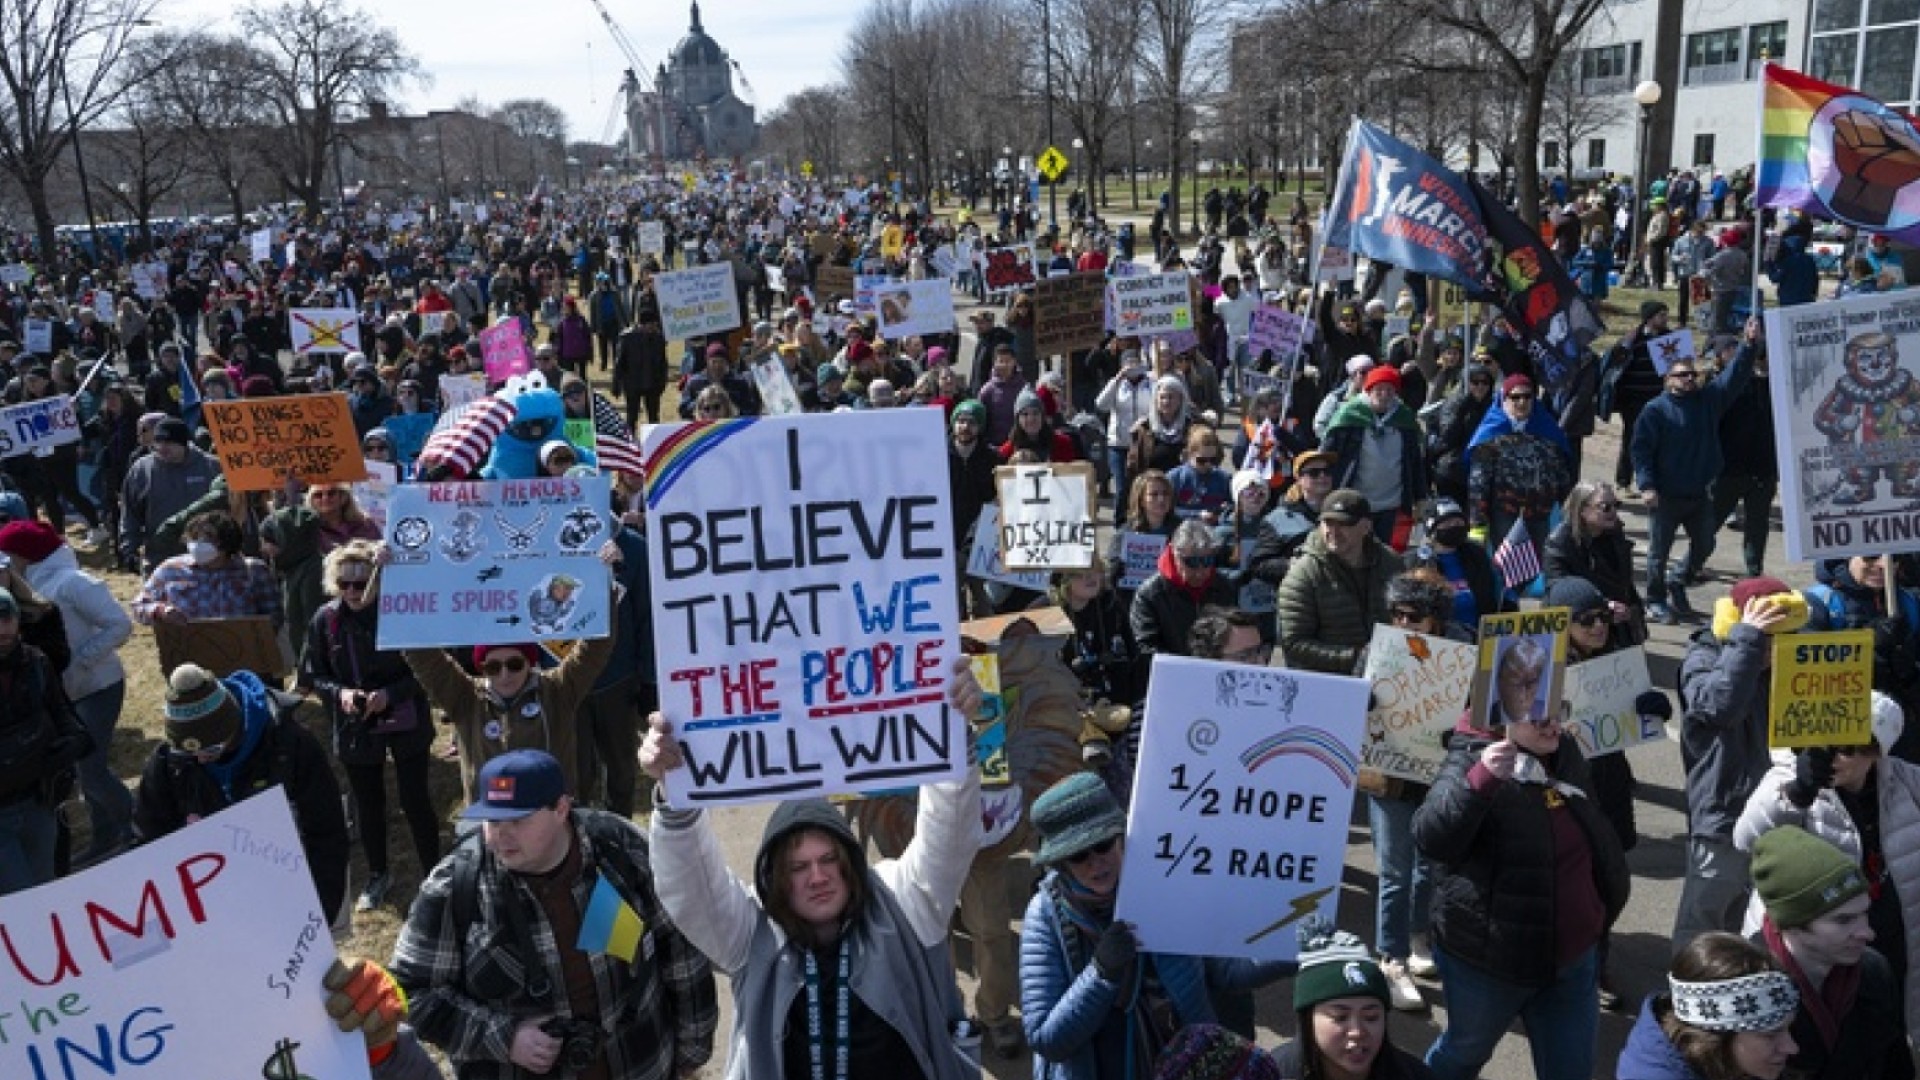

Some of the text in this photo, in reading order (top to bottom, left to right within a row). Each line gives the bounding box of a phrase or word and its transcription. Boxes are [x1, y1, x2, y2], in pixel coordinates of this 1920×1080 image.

[212, 402, 304, 425] NO KINGS
[220, 425, 248, 444] NO
[226, 452, 254, 470] NO
[786, 428, 801, 491] I
[428, 481, 481, 503] REAL
[502, 478, 580, 501] HEROES
[1023, 469, 1051, 504] I
[659, 495, 944, 581] BELIEVE
[1003, 520, 1095, 551] DISLIKE
[1812, 520, 1852, 549] NO
[381, 589, 519, 615] BONE SPURS
[663, 574, 942, 654] THAT WE
[1519, 610, 1568, 635] KING
[1796, 643, 1863, 665] STOP!
[670, 639, 946, 718] THE PEOPLE
[1790, 671, 1864, 694] CRIMES
[1784, 695, 1865, 720] AGAINST
[1774, 713, 1868, 738] HUMANITY
[680, 702, 950, 787] WILL WIN
[1233, 785, 1328, 823] HOPE
[223, 823, 304, 874] Thieves
[1227, 848, 1318, 884] RAGE
[27, 1006, 175, 1080] ING
